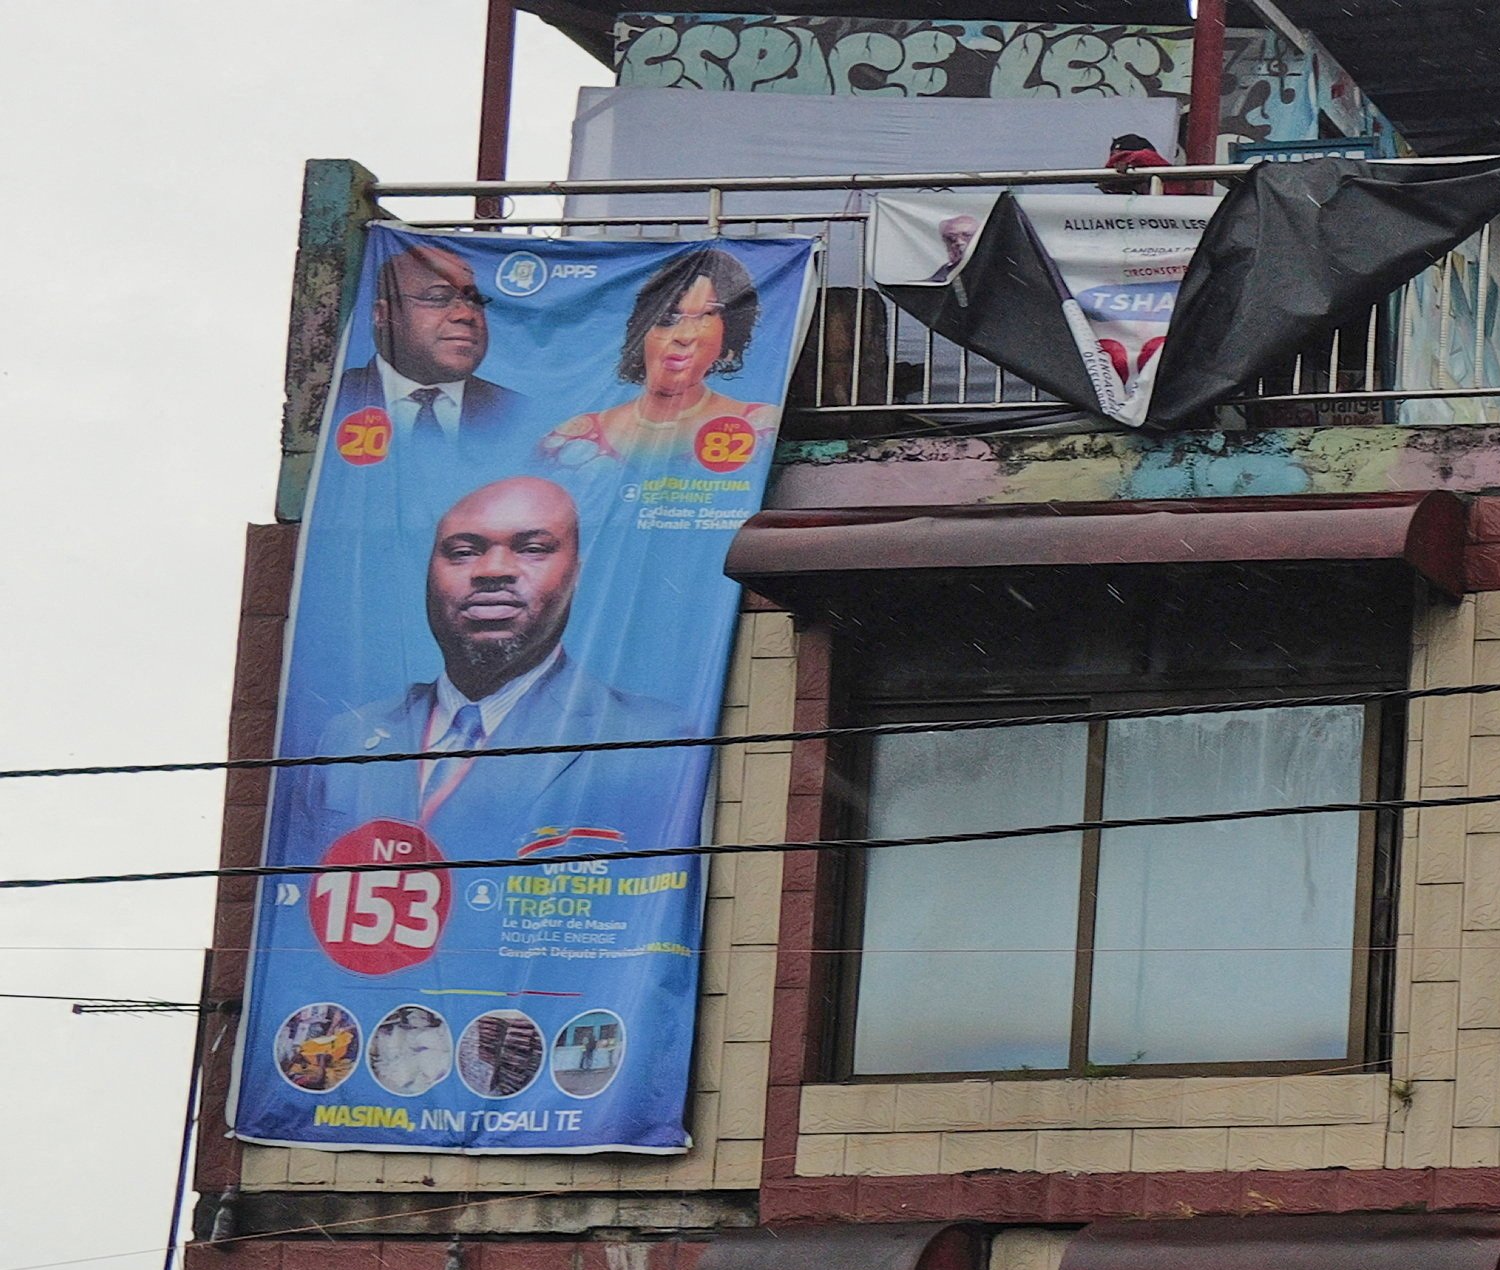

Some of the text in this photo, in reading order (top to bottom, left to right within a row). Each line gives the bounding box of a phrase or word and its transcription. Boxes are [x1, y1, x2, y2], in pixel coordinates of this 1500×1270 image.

[1065, 219, 1179, 230] ALLIANCE POUR
[550, 263, 597, 280] APPS
[341, 423, 389, 455] 20
[702, 432, 752, 463] 82
[618, 872, 688, 895] KILUBU
[316, 869, 442, 949] 153
[314, 1105, 582, 1131] MASINA, TE
